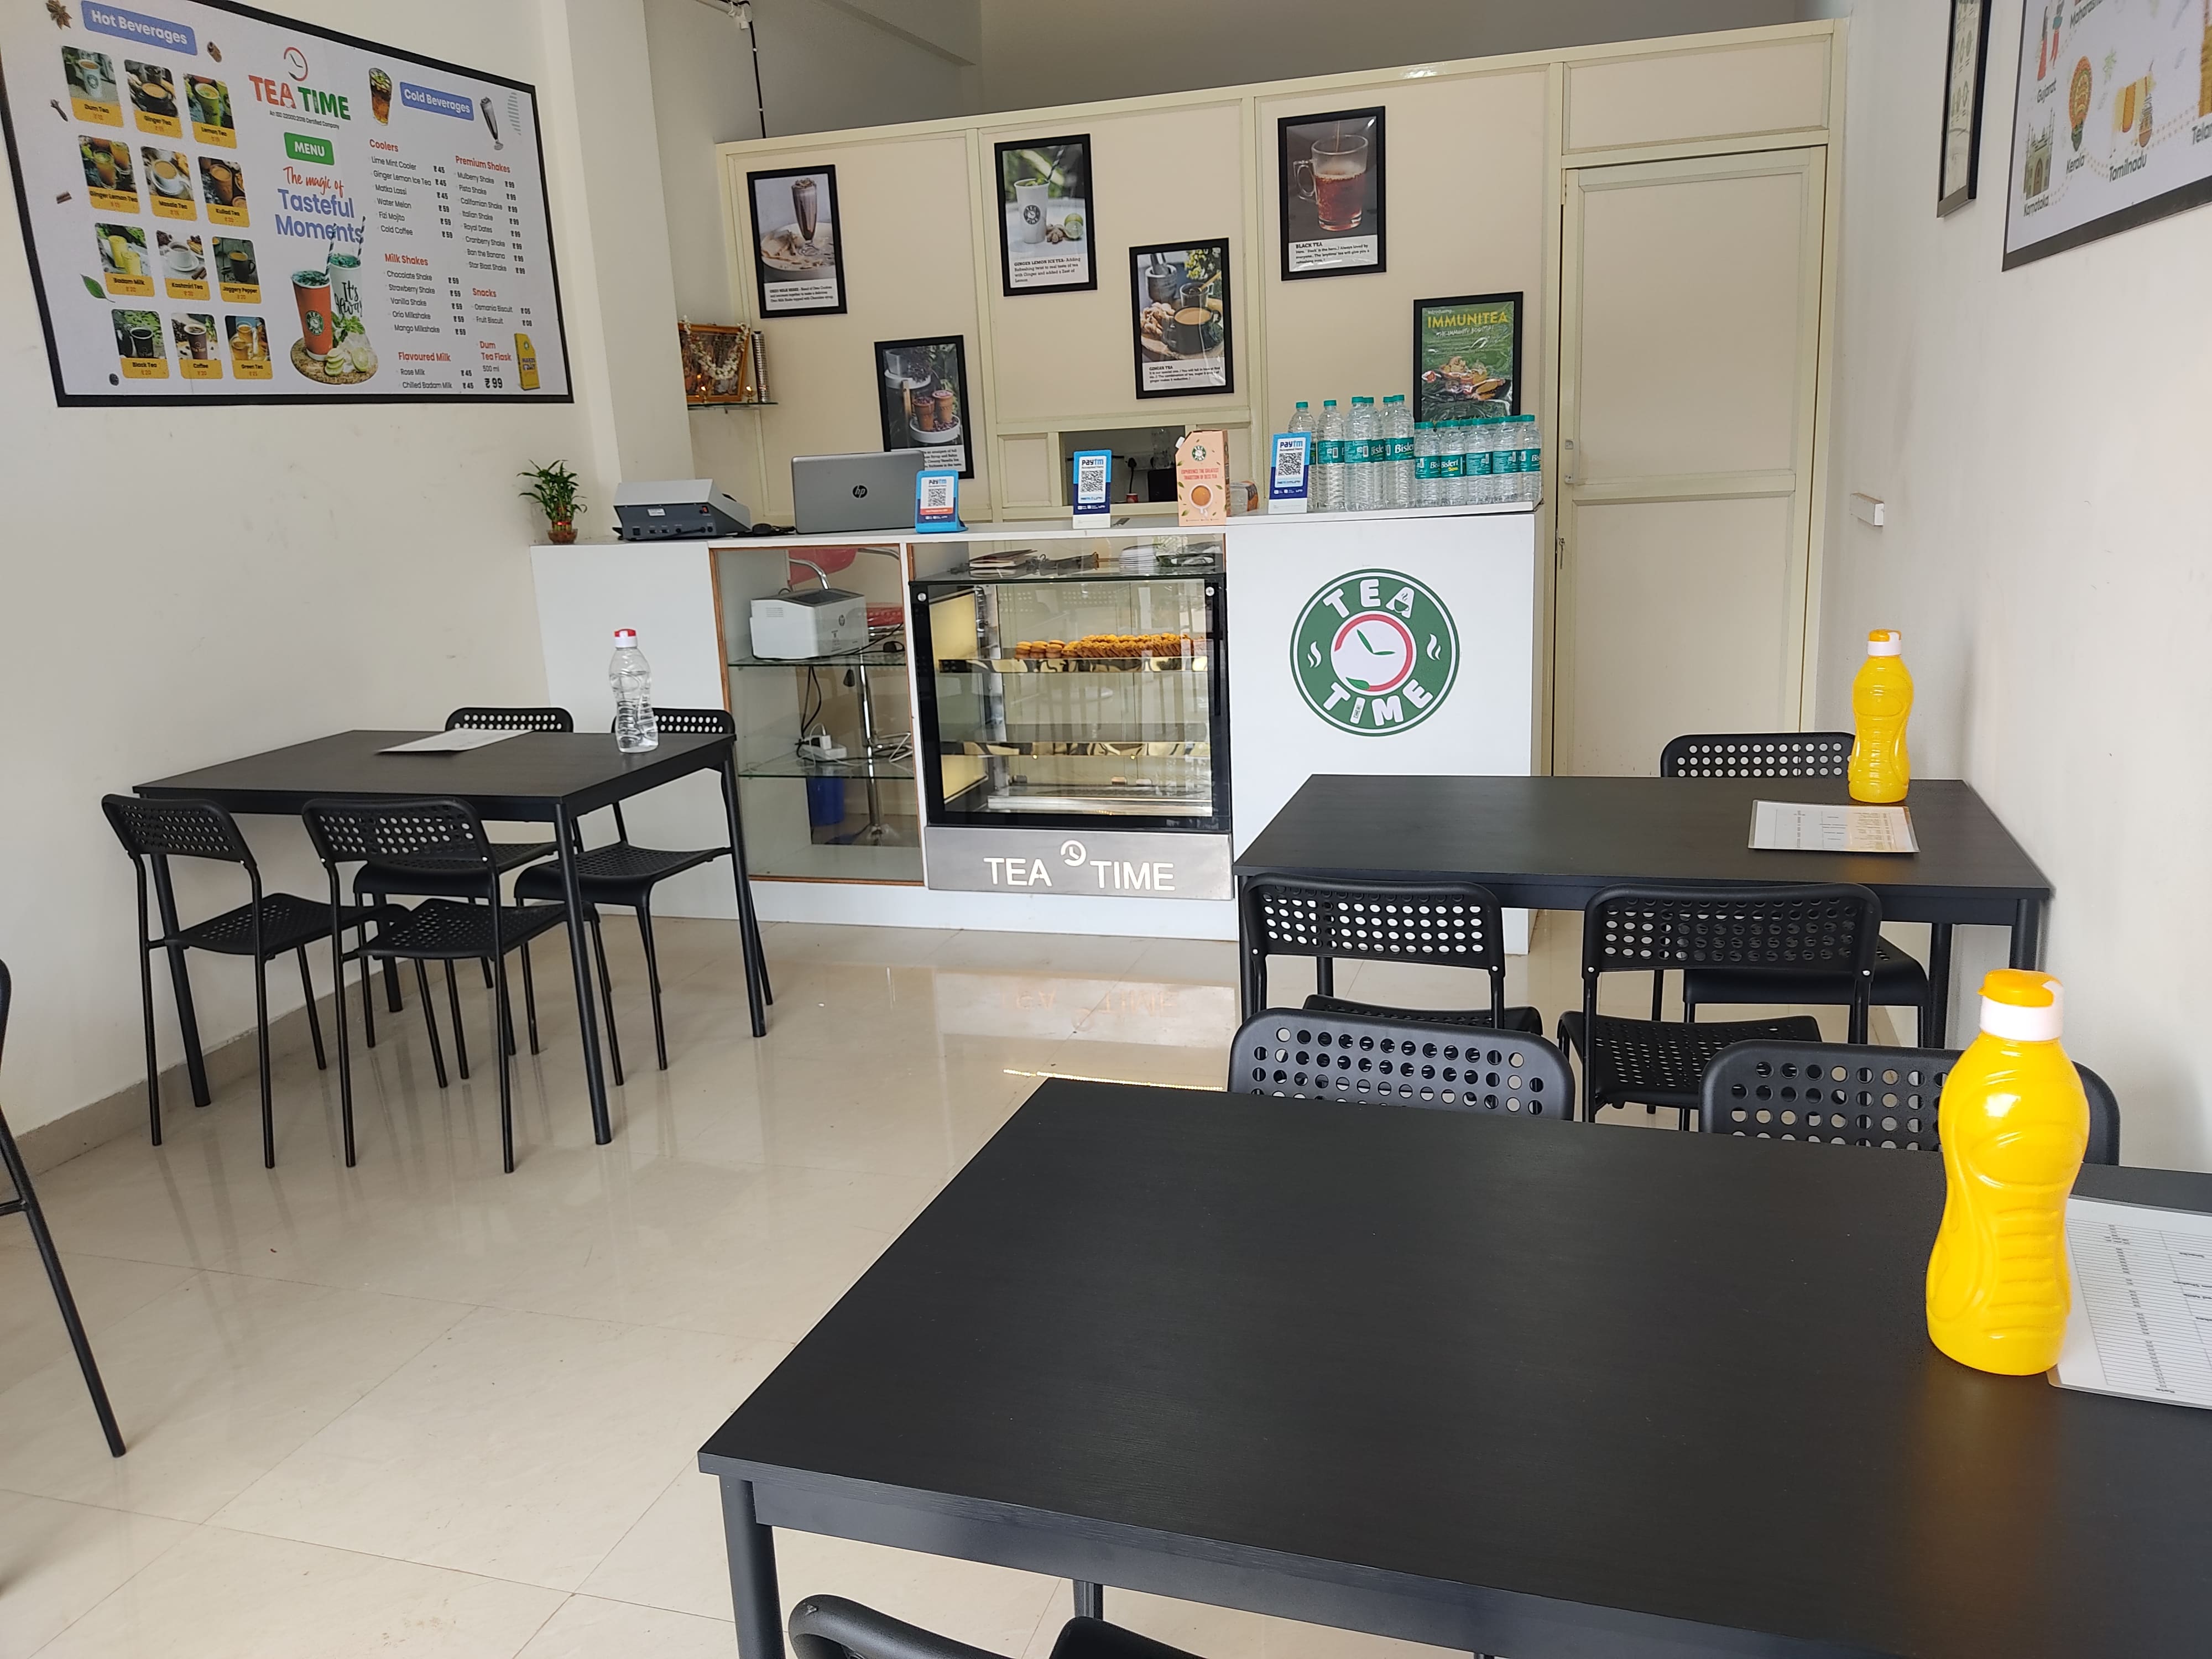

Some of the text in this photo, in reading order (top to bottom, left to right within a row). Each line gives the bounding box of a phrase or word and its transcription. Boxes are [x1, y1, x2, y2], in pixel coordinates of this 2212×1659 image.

[92, 9, 187, 45] Hot Beverages
[2037, 77, 2057, 103] Gujarat
[248, 75, 351, 121] TEA TIME
[404, 88, 470, 113] Cold Beverages
[306, 117, 322, 126] Certified
[322, 121, 340, 130] Company
[201, 127, 218, 135] Lemon
[294, 141, 325, 157] MENU
[369, 139, 399, 152] Coolers
[372, 156, 416, 170] Lime Mint Cooler
[456, 155, 510, 173] Premium Shakes
[2065, 154, 2085, 174] Kerala
[2109, 152, 2147, 182] Tamilnadu
[283, 166, 344, 198] The magic of
[373, 170, 392, 181] Ginger
[393, 173, 412, 182] Lemon
[457, 171, 494, 184] Mulberry Shake
[375, 184, 393, 193] Matka
[472, 187, 487, 195] Shake
[278, 188, 354, 218] Tasteful
[377, 198, 411, 209] Water Melon
[461, 197, 503, 210] Californian Shake
[2023, 194, 2049, 217] Karnataka
[388, 213, 405, 222] Mojito
[275, 213, 364, 243] Moments
[380, 225, 413, 236] Cold Coffee
[463, 223, 492, 233] Royal Dates
[466, 236, 505, 247] Cranberry Shake
[385, 253, 429, 266] Milk Shakes
[387, 270, 415, 279] Chocolate
[389, 284, 418, 294] Strawberry
[472, 288, 497, 298] Snacks
[390, 297, 409, 305] Vanilla
[474, 304, 497, 312] Osmania
[1427, 311, 1509, 328] IMMUNITEA
[394, 324, 414, 333] Mango
[479, 341, 495, 349] Dum
[398, 352, 451, 362] Flavoured Milk
[494, 353, 512, 361] Flask
[492, 378, 503, 389] 99
[1441, 460, 1458, 468] Bisleri
[855, 485, 866, 498] hp
[1322, 578, 1415, 619] TEA
[1323, 679, 1434, 727] TIME
[983, 857, 1176, 891] TEA TIME
